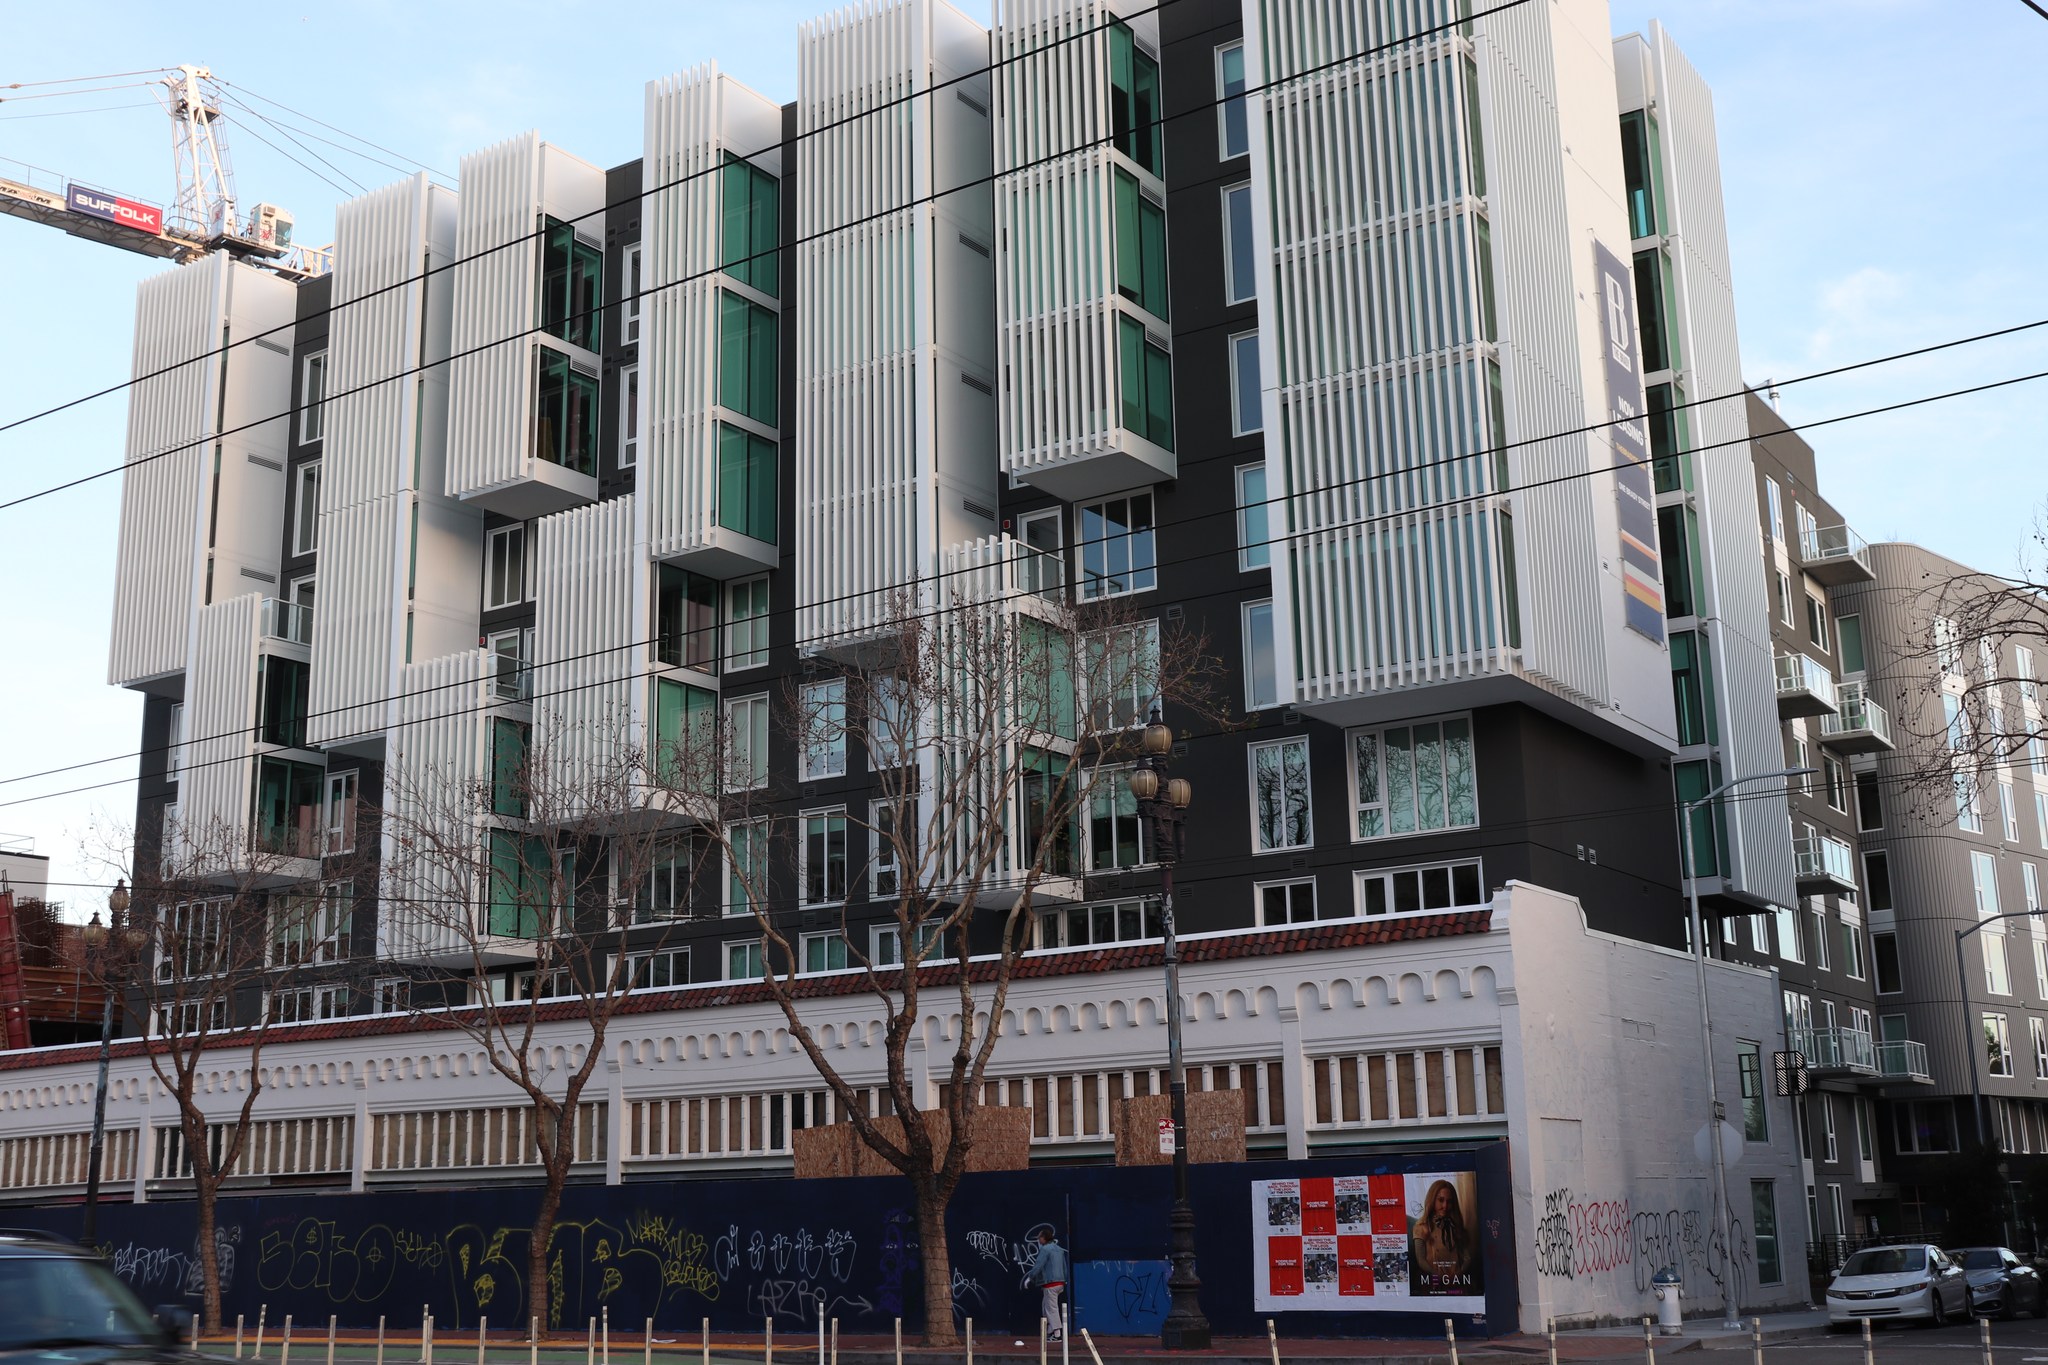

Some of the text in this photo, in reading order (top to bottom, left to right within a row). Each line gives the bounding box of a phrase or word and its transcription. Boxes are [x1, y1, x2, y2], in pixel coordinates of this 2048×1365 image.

[76, 194, 155, 225] SUFFOLK
[1605, 271, 1629, 351] B
[1618, 396, 1634, 421] NOW
[1613, 410, 1644, 446] LEASING
[1618, 481, 1650, 511] ONE BRADY STREET
